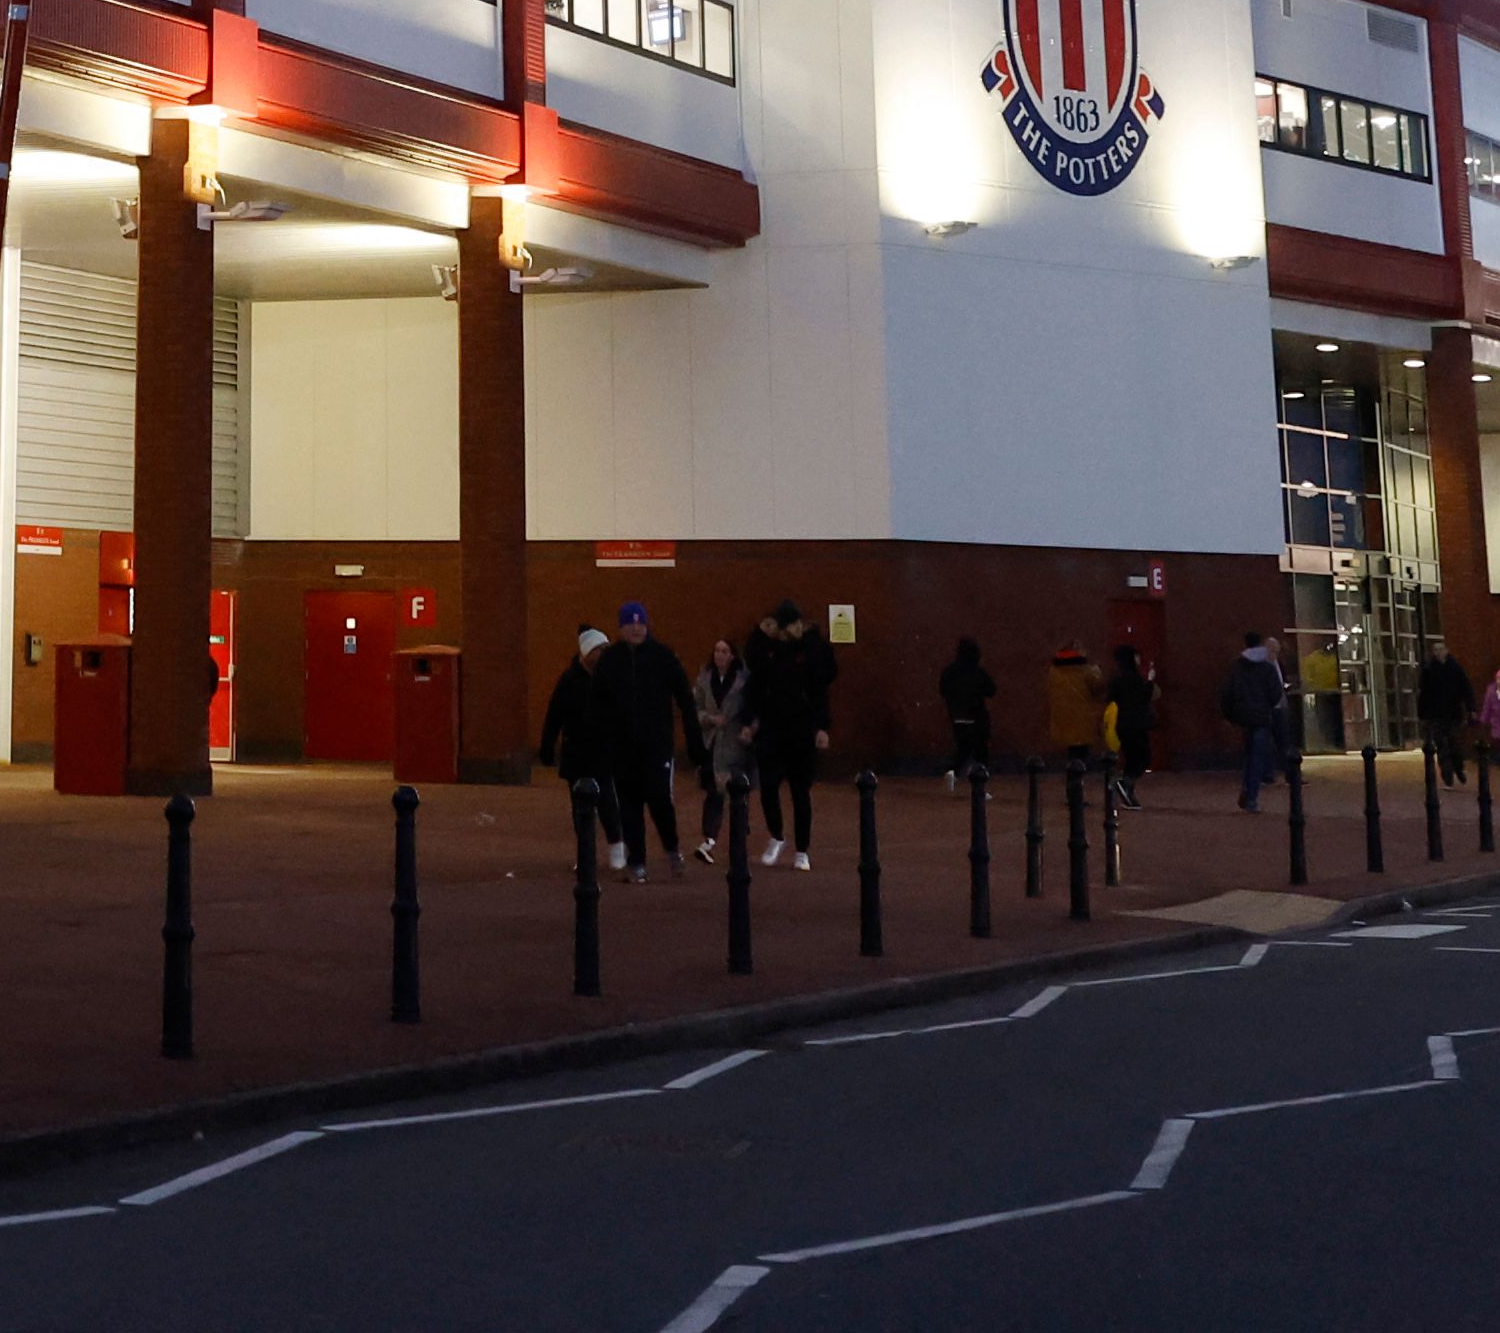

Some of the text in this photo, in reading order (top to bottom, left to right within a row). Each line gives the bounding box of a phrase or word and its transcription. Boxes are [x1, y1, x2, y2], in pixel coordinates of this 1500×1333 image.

[1053, 95, 1101, 132] 1863
[1012, 101, 1140, 186] THE POTTERS
[1153, 567, 1162, 590] E
[411, 596, 425, 619] F
